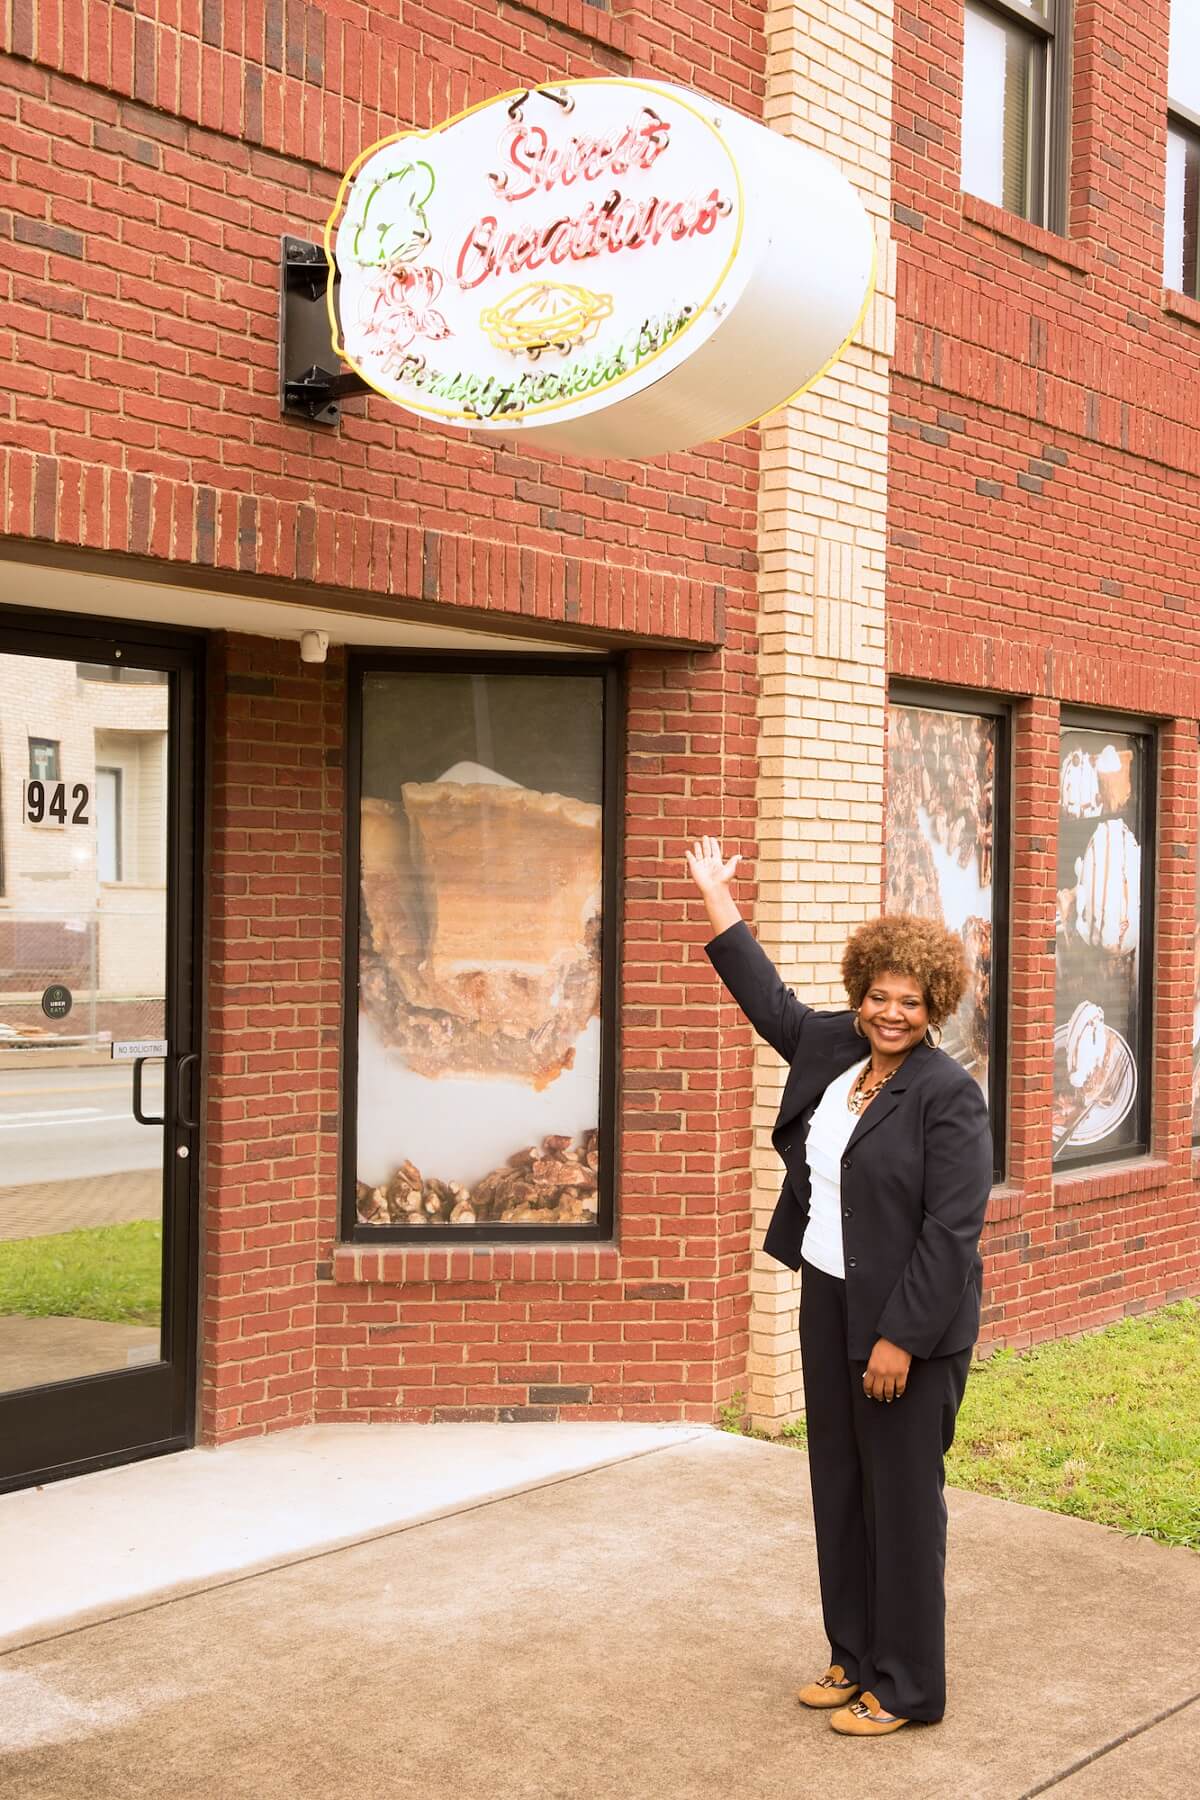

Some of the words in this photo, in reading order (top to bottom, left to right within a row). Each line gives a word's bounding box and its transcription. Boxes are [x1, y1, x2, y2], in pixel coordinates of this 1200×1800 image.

[27, 780, 89, 825] 942
[118, 1046, 128, 1054] NO
[129, 1044, 163, 1054] SOLICITING
